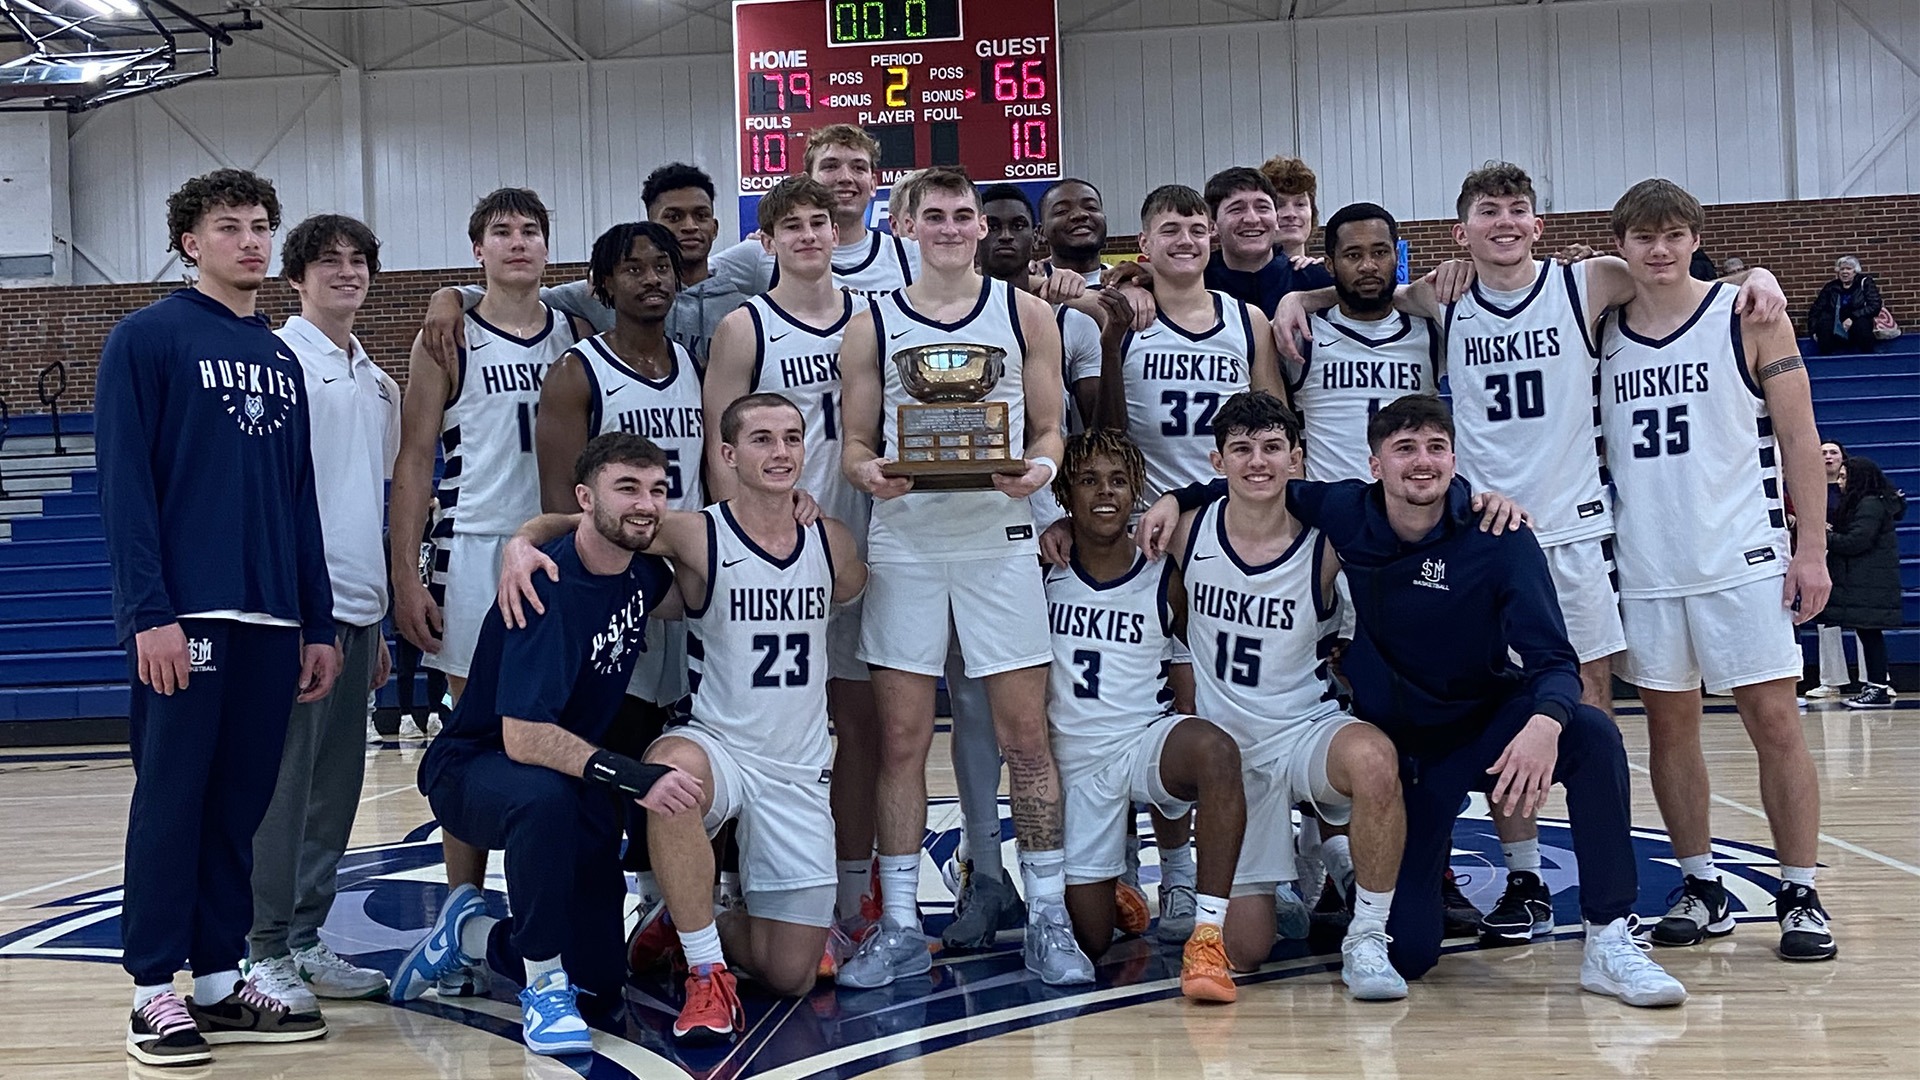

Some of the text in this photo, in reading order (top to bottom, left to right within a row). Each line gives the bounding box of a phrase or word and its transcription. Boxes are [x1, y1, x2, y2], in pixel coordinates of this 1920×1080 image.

[749, 50, 807, 70] HOME
[870, 53, 923, 67] PERIOD
[975, 37, 1050, 57] GUEST
[829, 72, 863, 86] POSS
[886, 67, 908, 107] 2
[929, 67, 964, 80] POSS
[994, 60, 1046, 101] 66
[763, 72, 811, 111] 79
[829, 94, 872, 107] BONUS
[922, 89, 964, 103] BONUS
[745, 116, 792, 130] FOULS
[858, 107, 963, 125] PLAYER FOUL
[1004, 103, 1051, 117] FOULS
[752, 133, 786, 173] 10
[1012, 120, 1047, 161] 10
[741, 176, 790, 190] SCOR
[1004, 163, 1057, 177] SCORE
[1464, 327, 1560, 366] HUSKIES
[198, 360, 297, 405] HUSKIES
[482, 363, 553, 395] HUSK
[780, 353, 842, 388] HUSK
[1142, 353, 1240, 383] HUSKIES
[1323, 361, 1422, 391] HUSKIES
[1614, 362, 1709, 404] HUSKIES
[1485, 370, 1545, 422] 30
[618, 407, 704, 439] HUSKIES
[1161, 390, 1221, 436] 32
[1632, 405, 1690, 459] 35
[1412, 580, 1450, 591] BASKETBALL
[730, 587, 825, 621] HUSKIES
[1194, 582, 1296, 630] HUSKIES
[752, 632, 810, 688] 23
[1073, 649, 1101, 700] 3
[1216, 630, 1262, 687] 15
